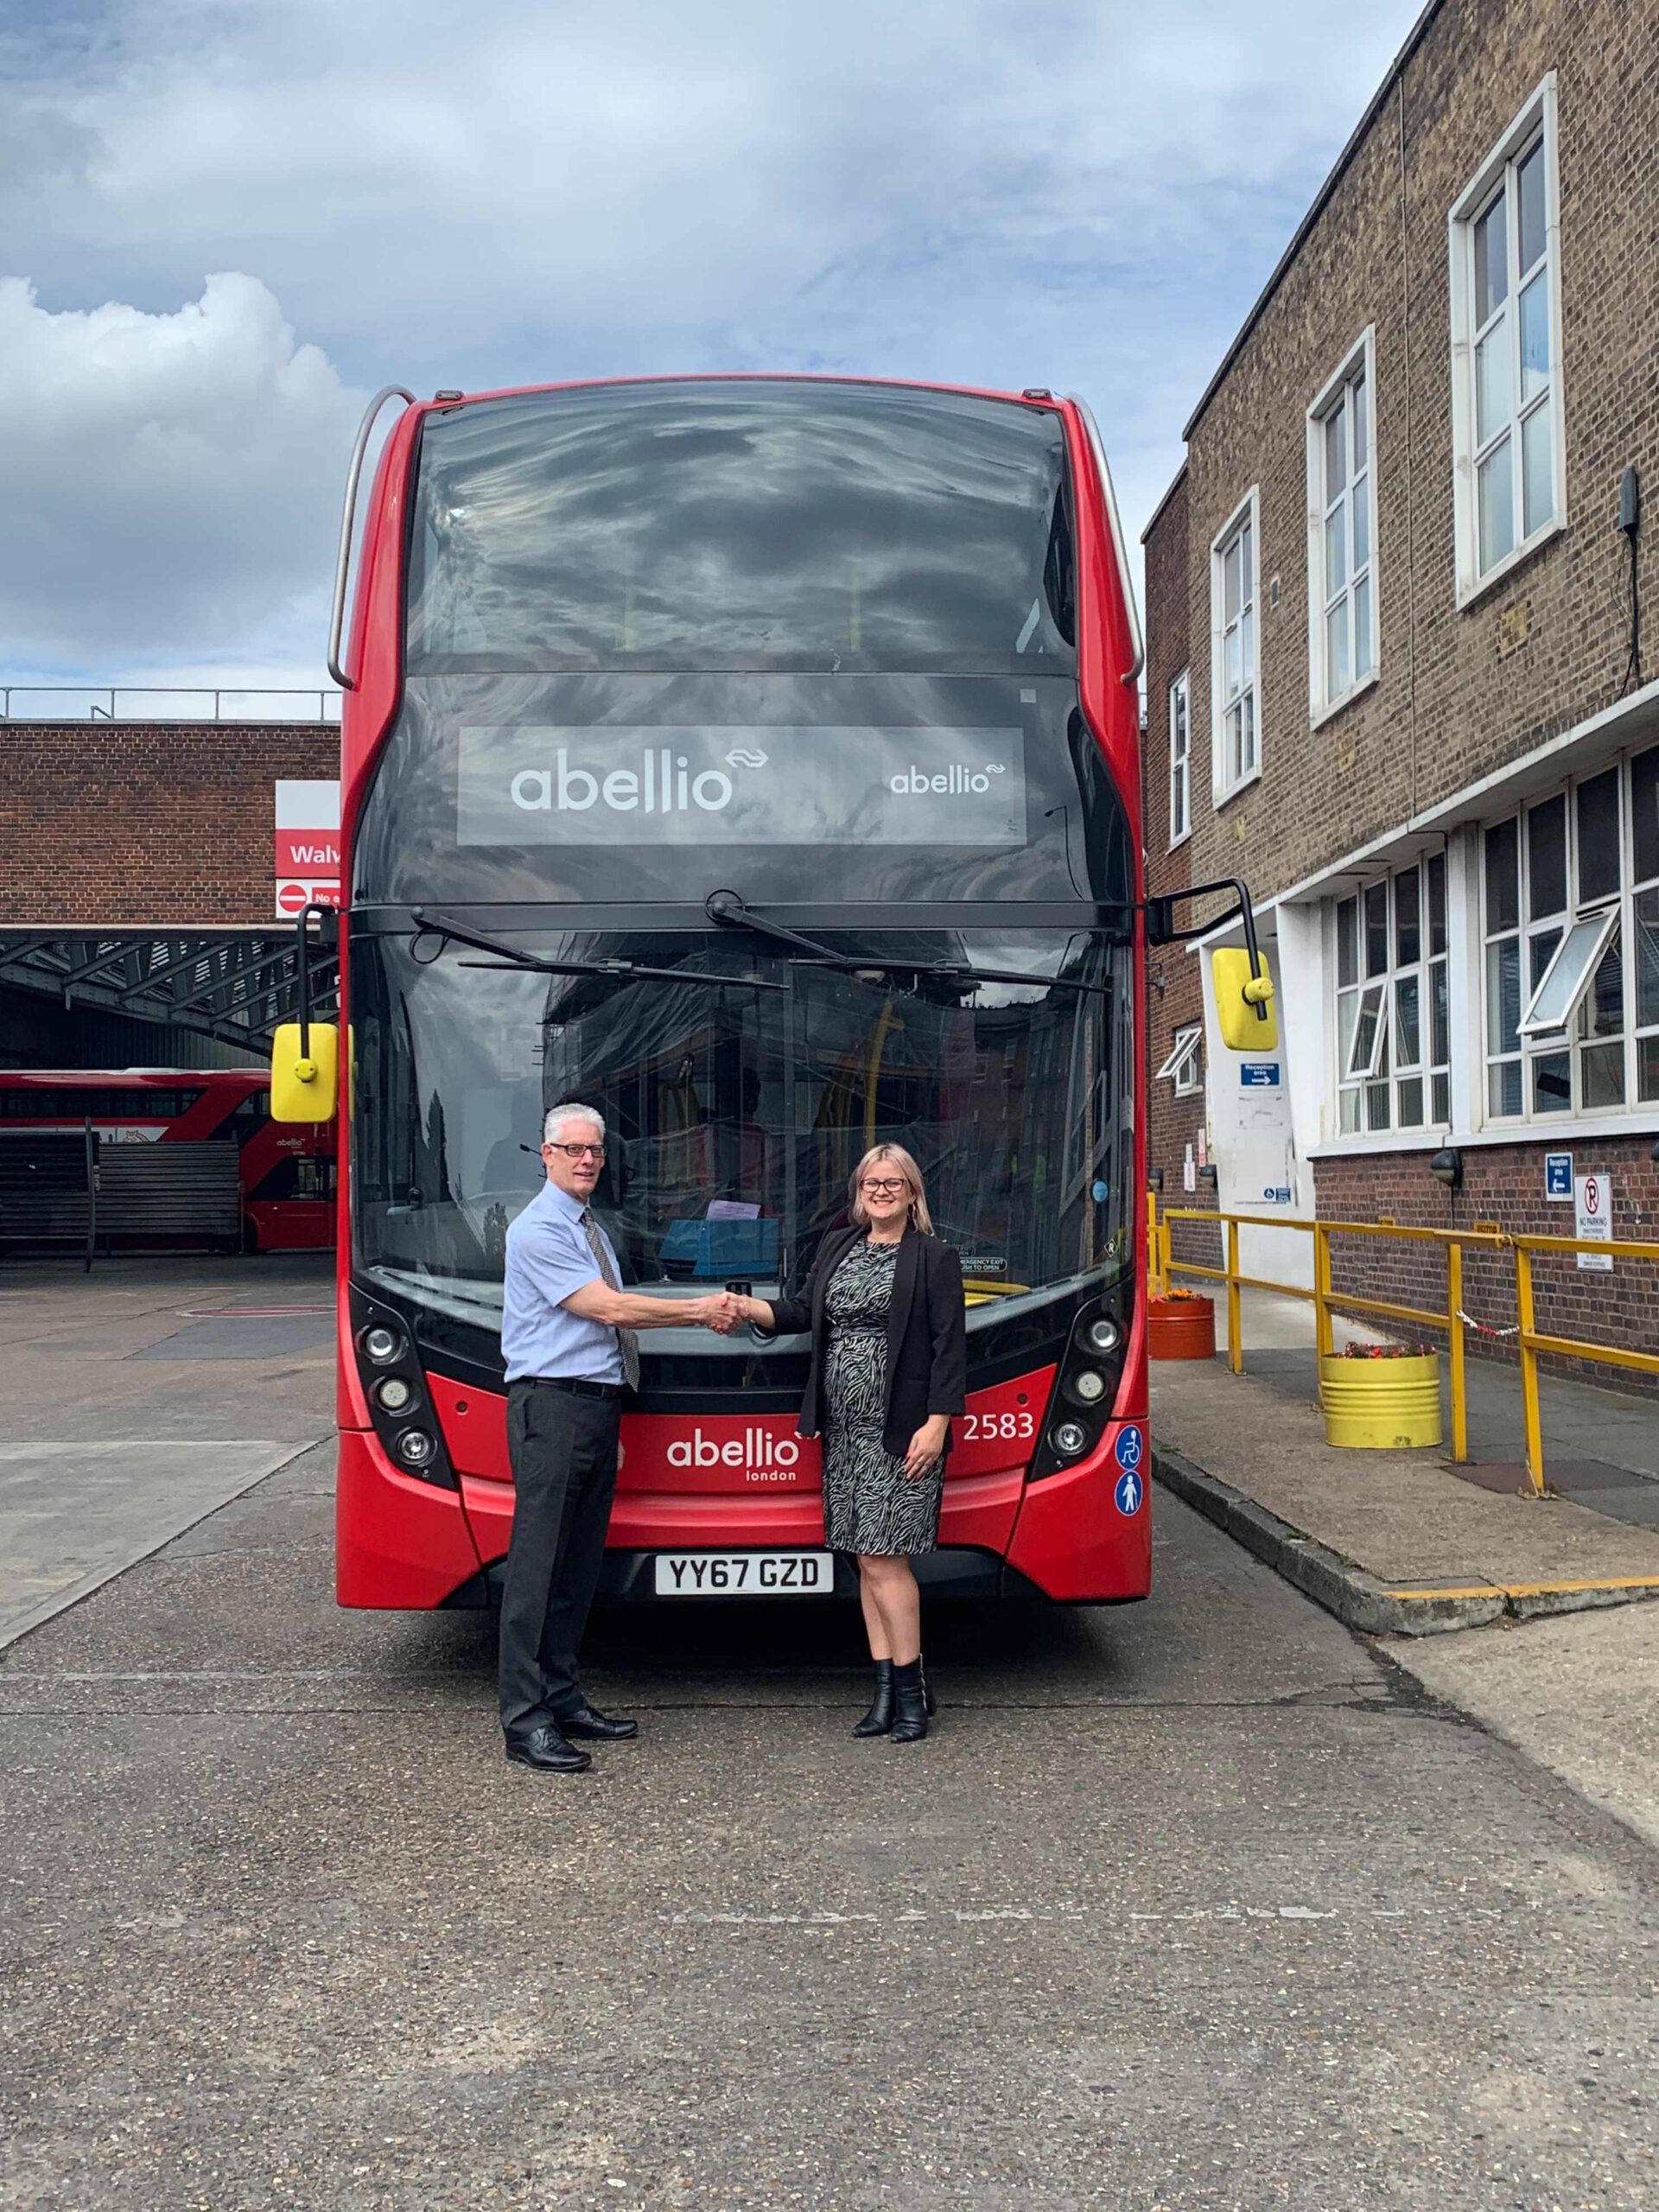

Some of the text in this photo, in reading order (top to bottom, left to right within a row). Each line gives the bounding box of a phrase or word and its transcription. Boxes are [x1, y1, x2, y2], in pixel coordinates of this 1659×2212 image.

[510, 747, 733, 814] abellio
[889, 764, 989, 795] abellio
[315, 893, 330, 903] No
[963, 1413, 1034, 1440] 2583
[666, 1427, 799, 1468] abellio
[746, 1470, 797, 1481] london
[670, 1558, 818, 1588] YY67 GZD
